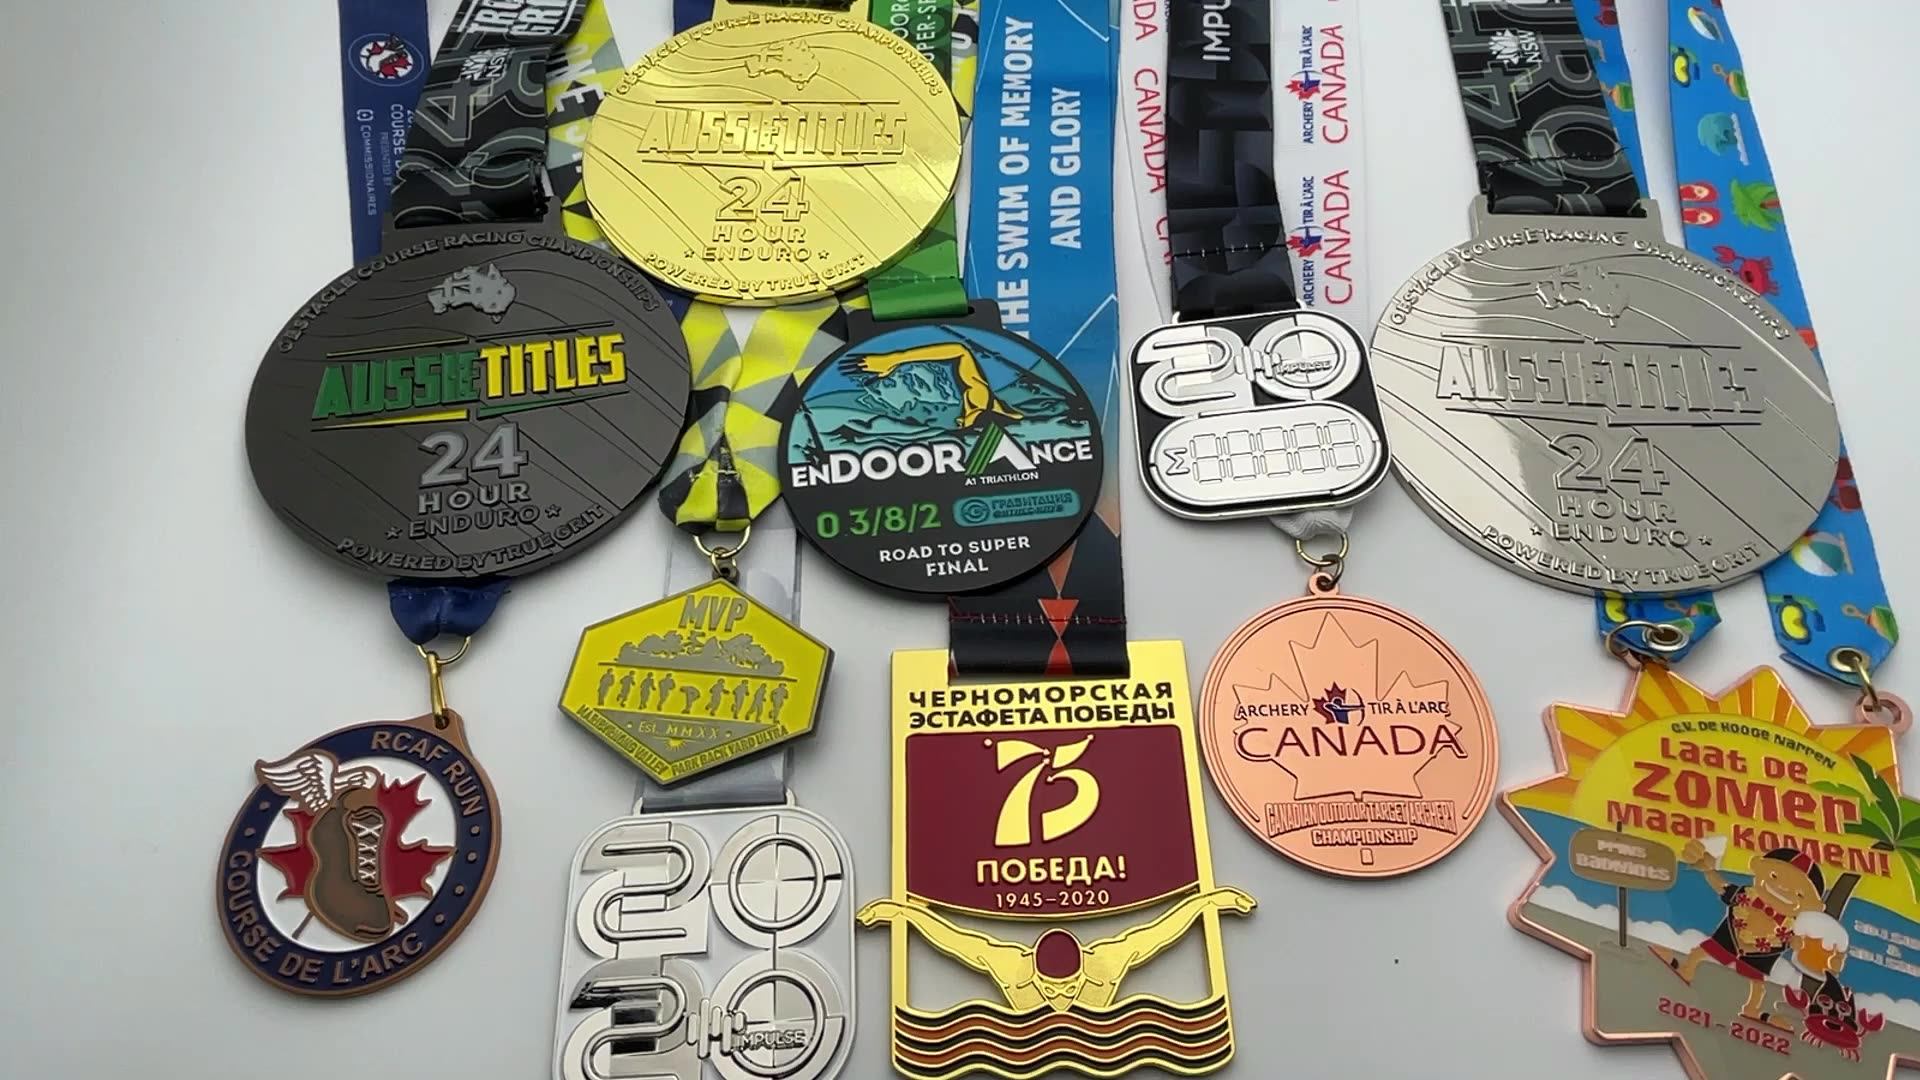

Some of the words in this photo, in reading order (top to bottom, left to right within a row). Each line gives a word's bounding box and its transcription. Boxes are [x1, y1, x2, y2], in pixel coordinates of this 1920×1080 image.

[616, 36, 693, 97] OBSTACLE
[694, 12, 760, 43] COURSE
[764, 10, 833, 27] RACING
[836, 17, 944, 98] CHAMPIONSHIPS
[1518, 29, 1544, 63] NSW
[1000, 16, 1034, 127] MEMORY
[1319, 24, 1349, 144] CANADA
[390, 103, 406, 155] COURSE
[1050, 87, 1082, 177] GLORY
[1134, 68, 1169, 194] CANADA
[1303, 101, 1314, 144] ARCHERY
[999, 136, 1030, 176] OF
[715, 175, 811, 223] 24
[1050, 185, 1082, 249] AND
[711, 224, 808, 245] HOUR
[997, 184, 1030, 270] SWIM
[1323, 169, 1353, 305] CANADA
[357, 239, 440, 279] COURSE
[443, 230, 527, 249] RACING
[526, 233, 662, 312] CHAMPIONSHIPS
[643, 252, 734, 292] POWERED
[739, 279, 763, 293] BY
[766, 272, 820, 292] TRUE
[823, 253, 867, 281] GRIT
[701, 245, 813, 263] ENDURO
[1302, 259, 1315, 307] ARCHERY
[1390, 250, 1461, 325] OBSTACLE
[1459, 227, 1542, 262] COURSE
[1542, 226, 1630, 246] RACING
[1633, 239, 1792, 340] CHAMPIONSHIPS
[418, 421, 530, 489] 24
[1549, 433, 1671, 496] 24
[417, 480, 532, 516] HOUR
[964, 475, 978, 487] A1
[980, 471, 1040, 485] TRIATHLON
[407, 504, 541, 540] ENDURO
[1557, 495, 1678, 523] HOUR
[336, 537, 456, 572] POWERED
[456, 553, 488, 571] BY
[492, 533, 553, 564] TRUE
[552, 504, 605, 543] GRIT
[879, 545, 933, 563] ROAD
[937, 542, 964, 556] TO
[968, 536, 1031, 554] SUPER
[1481, 525, 1601, 581] POWERED
[1605, 567, 1641, 585] BY
[1643, 563, 1712, 586] TRUE
[1710, 542, 1763, 574] GRIT
[1551, 521, 1691, 549] ENDURO
[926, 558, 989, 577] FINAL
[678, 593, 749, 633] MVP
[909, 682, 1173, 708] ЧЕРНОМОРСКАЯ
[909, 707, 1048, 729] ЭСТАФЕТА
[1054, 702, 1176, 724] ПОБЕДЫ
[1236, 703, 1310, 719] ARCHERY
[1367, 701, 1394, 715] TIR
[1395, 698, 1407, 714] À
[1408, 700, 1450, 715] L'ARC
[634, 745, 670, 776] VALLEY
[671, 760, 700, 776] PARK
[699, 746, 730, 768] BACK
[729, 738, 755, 759] YARD
[756, 725, 790, 746] ULTRA
[1236, 724, 1468, 759] CANADA
[371, 730, 449, 763] RCAF
[442, 760, 485, 818] RUN
[994, 732, 1101, 847] 75
[1264, 801, 1319, 839] CANADIAN
[1318, 801, 1369, 825] OUTDOOR
[1369, 800, 1408, 825] TARGET
[1408, 800, 1458, 836] ARCHERY
[1311, 828, 1419, 847] CHAMPIONSHIP
[976, 855, 1128, 886] ПОБЕДА!
[226, 850, 281, 963] COURSE
[277, 952, 324, 984] DE
[332, 931, 425, 985] L'ARC
